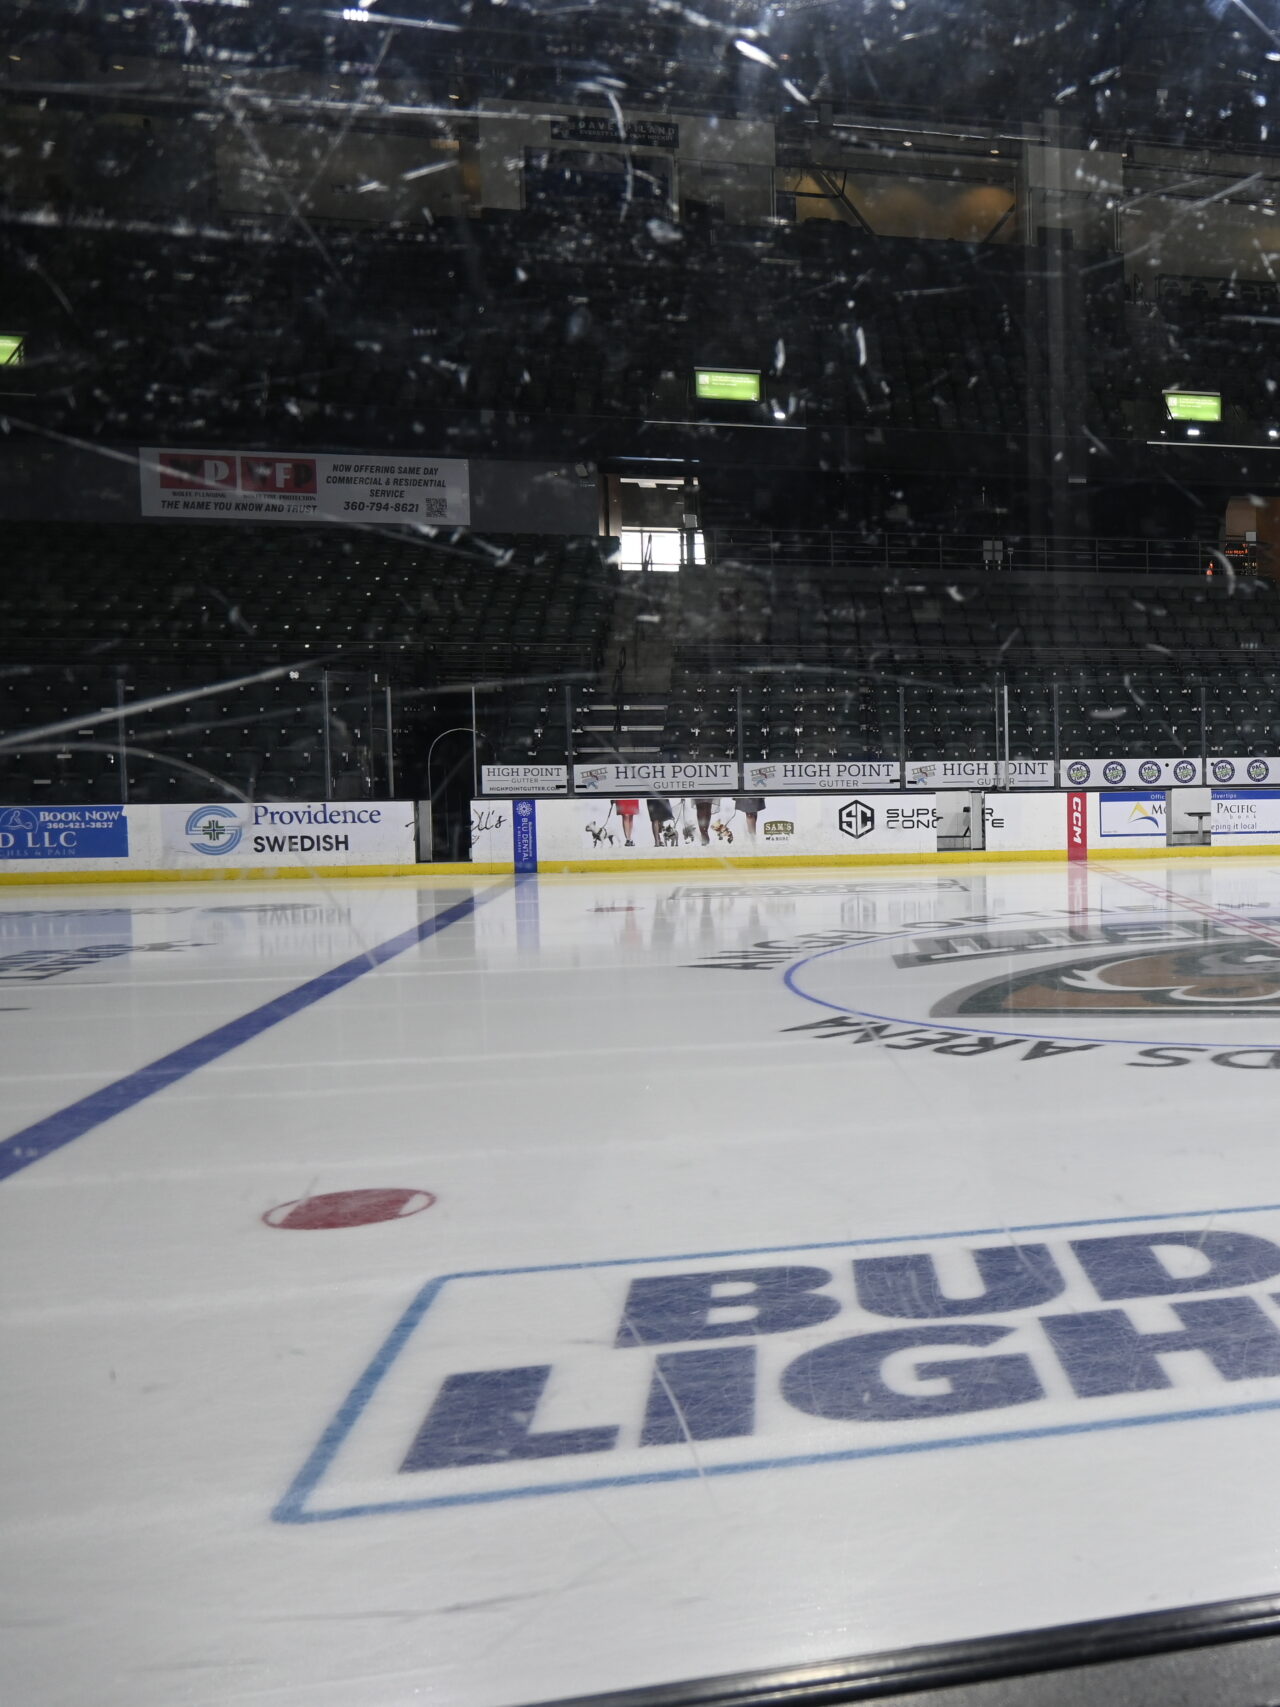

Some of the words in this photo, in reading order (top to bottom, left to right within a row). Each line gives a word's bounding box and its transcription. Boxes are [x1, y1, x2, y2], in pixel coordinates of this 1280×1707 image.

[332, 464, 351, 473] NOW
[354, 466, 395, 474] OFFERING
[397, 467, 420, 475] SAME
[423, 468, 439, 476] DAY
[326, 475, 382, 486] COMMERCIAL
[393, 478, 447, 488] RESIDENTIAL
[369, 489, 405, 498] SERVICE
[161, 500, 179, 509] THE
[183, 501, 211, 511] NAME
[213, 502, 232, 511] YOU
[234, 503, 262, 512] KNOW
[264, 503, 284, 513] AND
[286, 504, 317, 514] TRUST
[343, 501, 419, 513] 360-794-8621
[487, 768, 519, 777] HIGH
[524, 768, 562, 777] POINT
[615, 765, 665, 779] HIGH
[671, 764, 731, 779] POINT
[783, 764, 831, 778] HIGH
[837, 764, 894, 778] POINT
[943, 763, 988, 776] HIGH
[653, 781, 695, 789] GUTTER
[1217, 803, 1257, 813] PACIFIC
[40, 812, 81, 822] BOOK
[85, 811, 120, 821] NOW
[253, 804, 382, 826] Providence
[1072, 797, 1082, 844] CCM
[765, 823, 792, 831] SAM'S
[28, 831, 77, 848] LLC
[253, 834, 349, 852] SWEDISH
[777, 1016, 1106, 1061] ARENA
